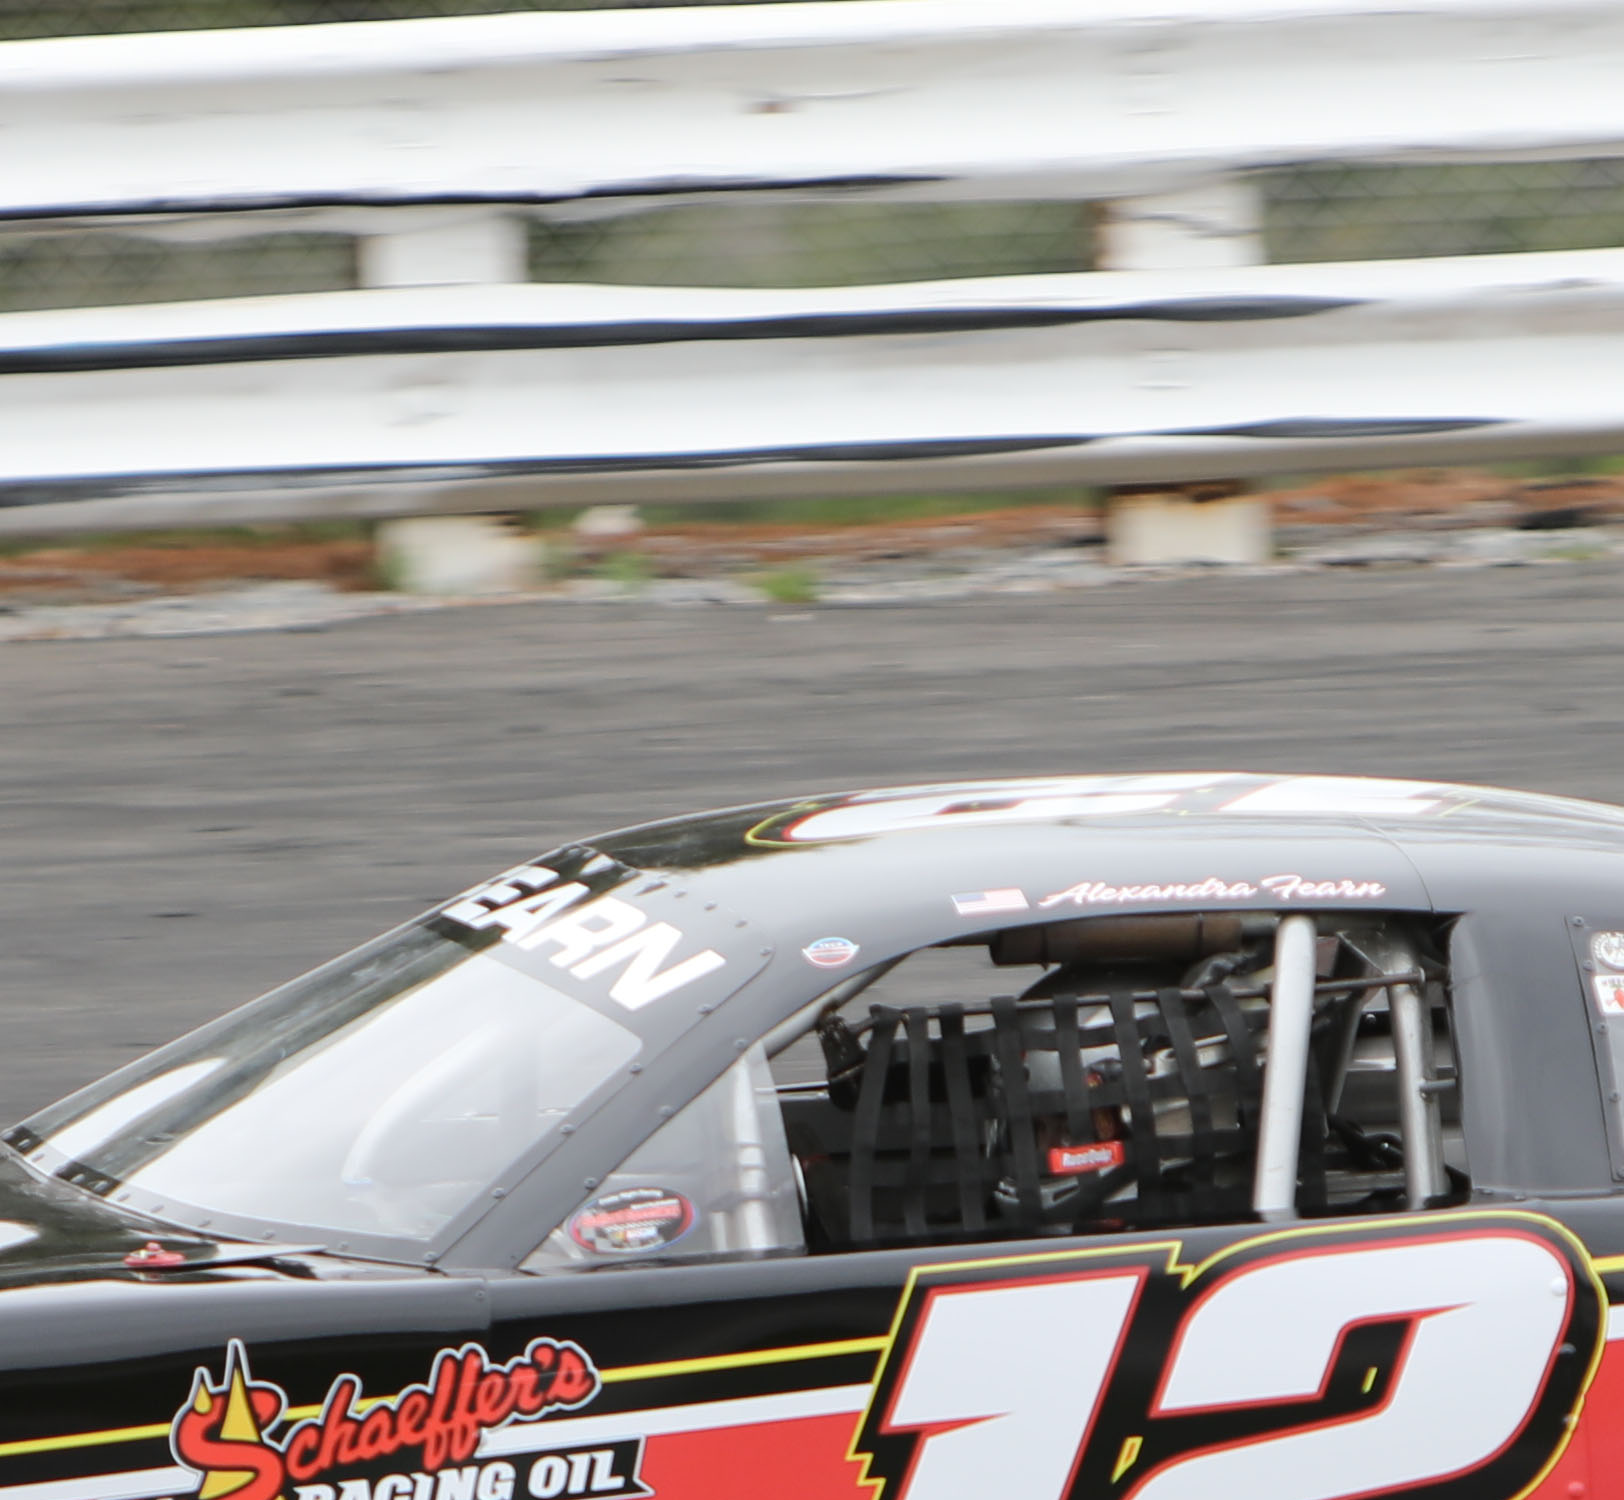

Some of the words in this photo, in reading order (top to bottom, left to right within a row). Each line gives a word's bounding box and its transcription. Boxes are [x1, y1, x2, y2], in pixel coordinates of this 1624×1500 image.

[1037, 877, 1259, 907] Alexandra
[1260, 873, 1387, 900] Fearn
[440, 865, 727, 1011] EARN
[526, 1449, 628, 1499] OIL
